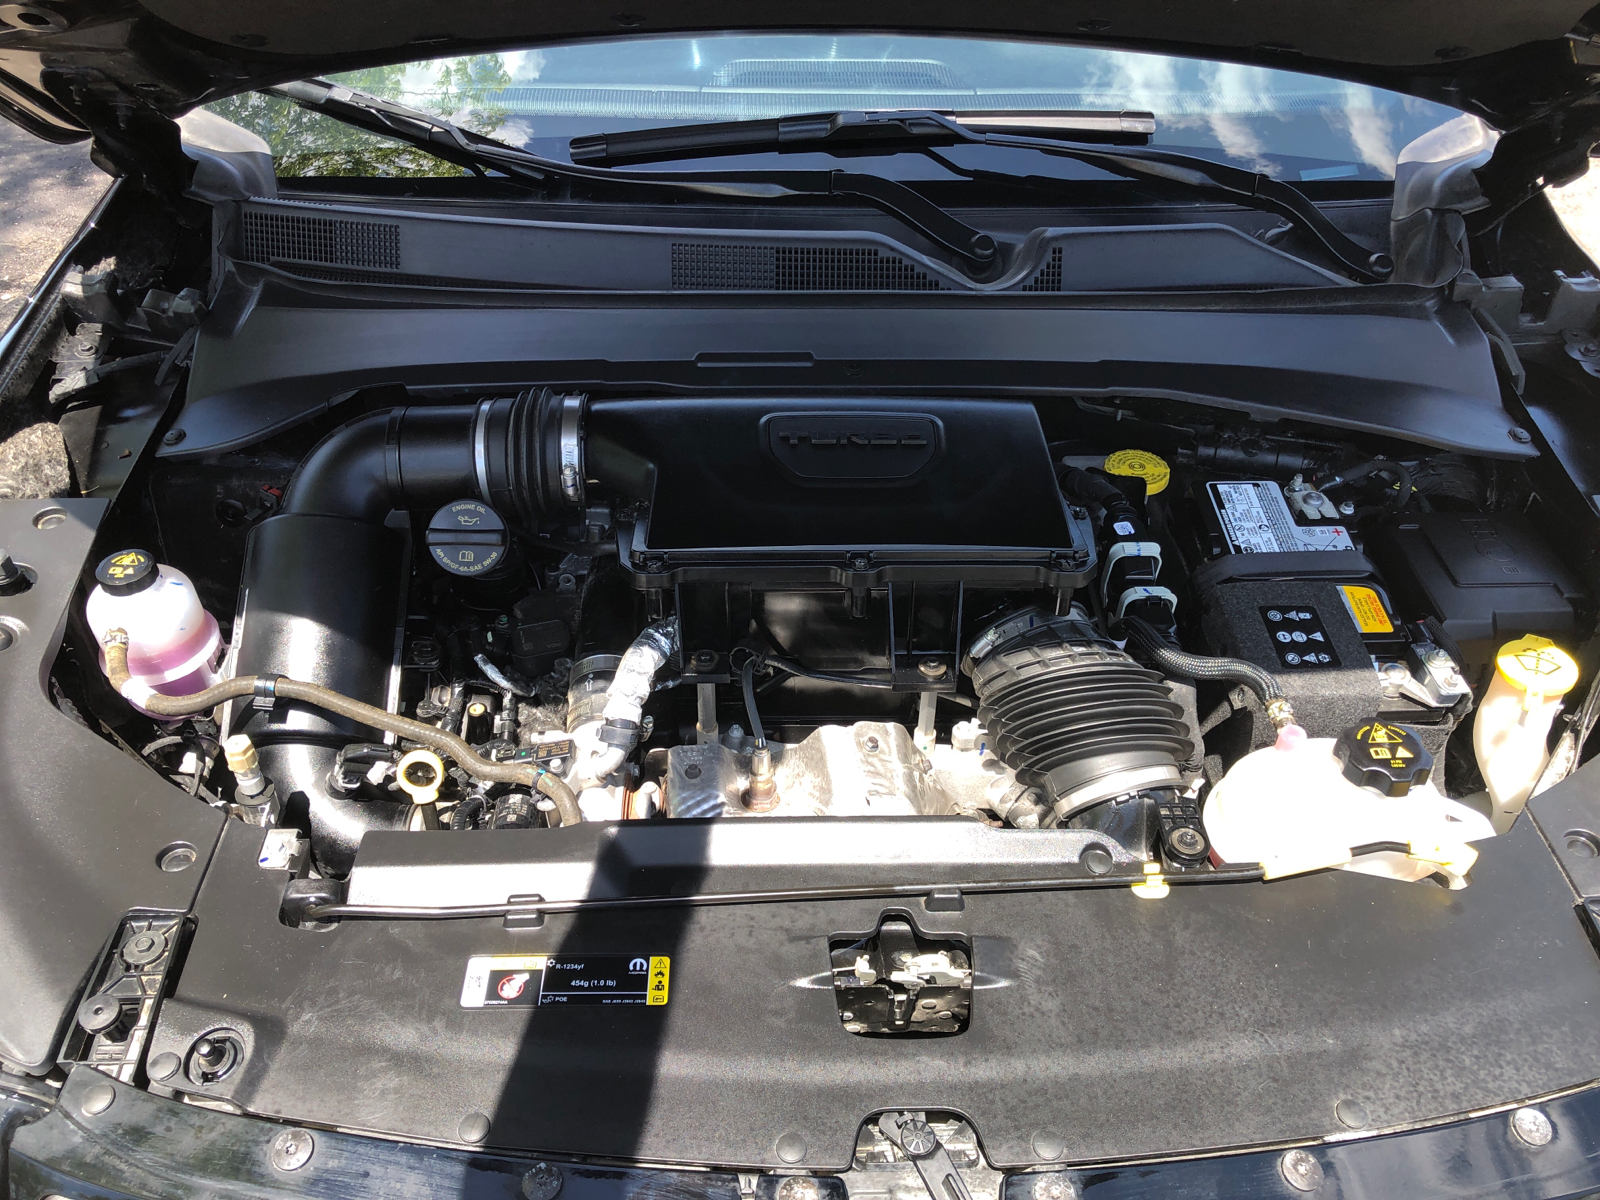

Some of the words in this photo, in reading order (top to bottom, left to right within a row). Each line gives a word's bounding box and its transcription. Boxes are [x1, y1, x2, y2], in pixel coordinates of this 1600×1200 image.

[452, 504, 476, 512] ENGINE
[476, 506, 486, 514] OIL
[436, 548, 444, 558] API
